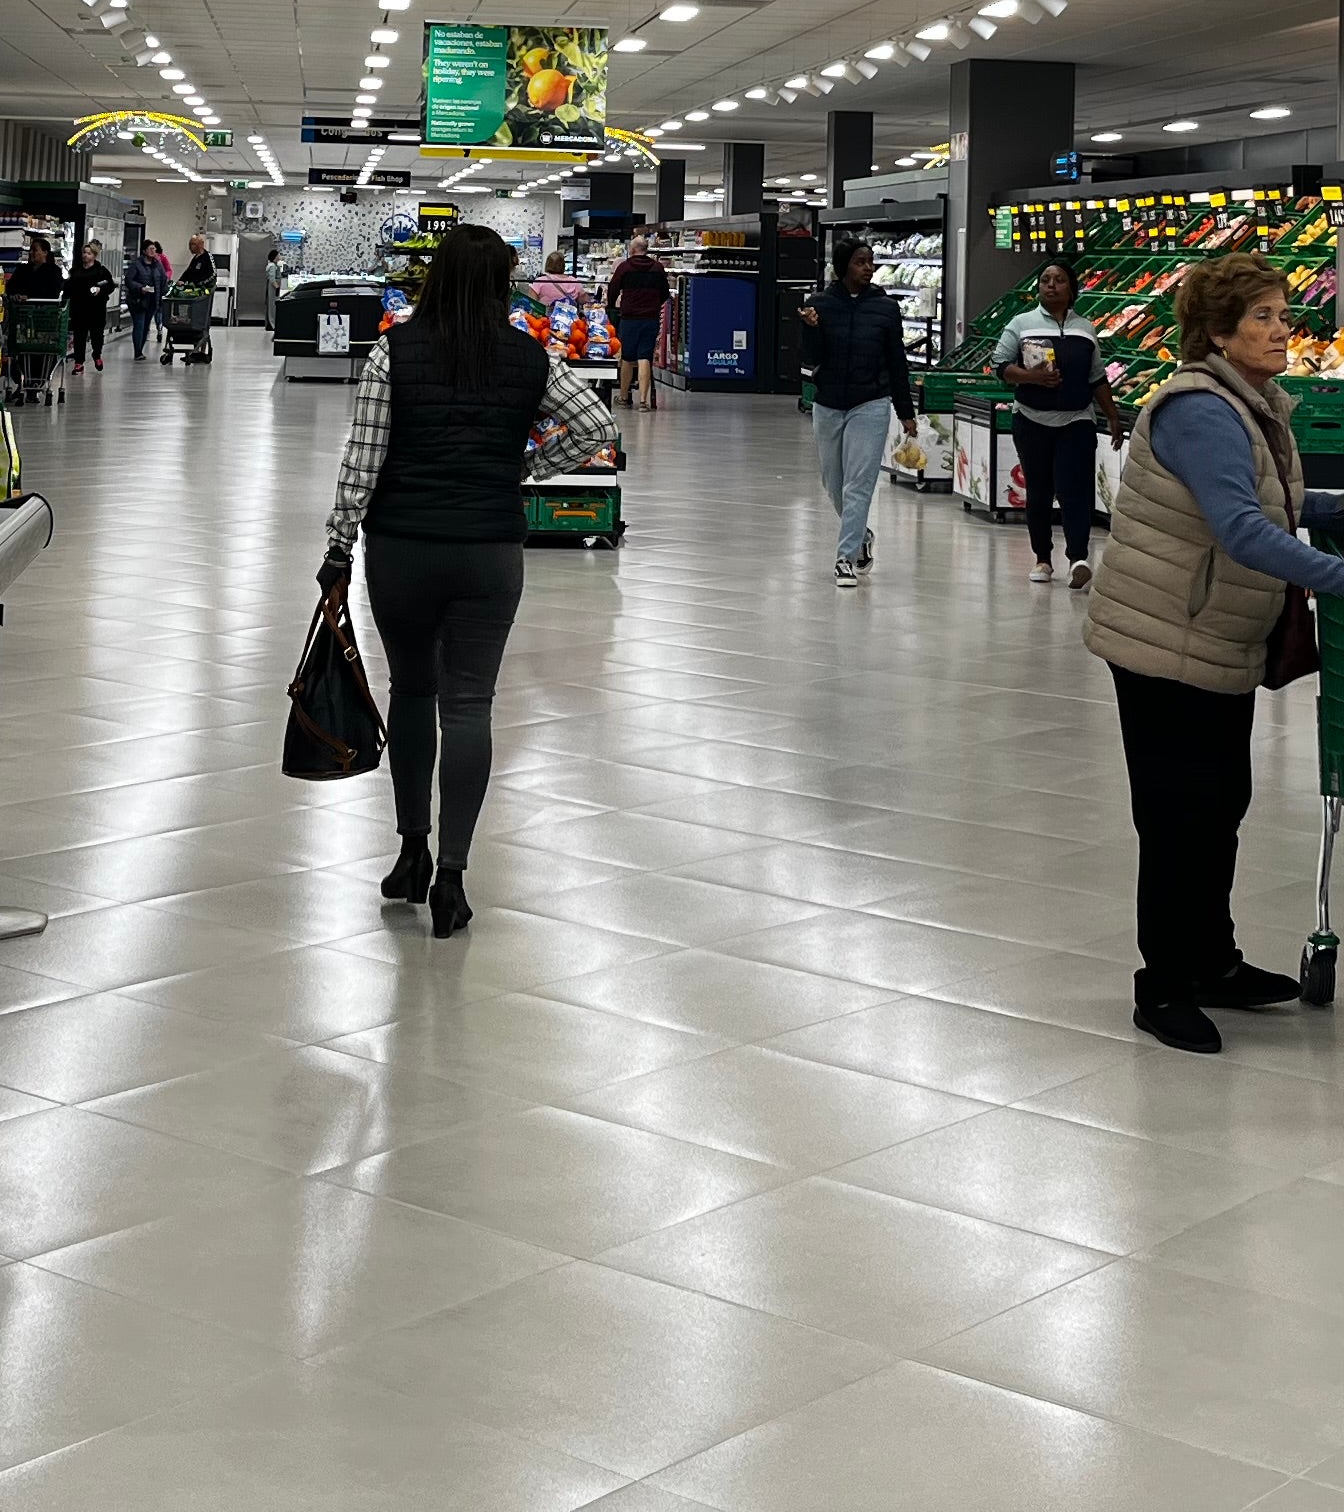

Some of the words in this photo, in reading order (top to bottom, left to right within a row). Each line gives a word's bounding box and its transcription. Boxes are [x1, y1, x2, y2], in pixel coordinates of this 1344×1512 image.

[434, 29, 445, 38] No
[446, 30, 474, 39] estaban
[474, 31, 484, 39] de
[475, 40, 503, 48] estaban
[433, 59, 451, 68] They
[460, 68, 476, 77] they
[371, 174, 386, 182] Fish
[386, 175, 404, 184] Shop
[707, 352, 738, 360] LARGO
